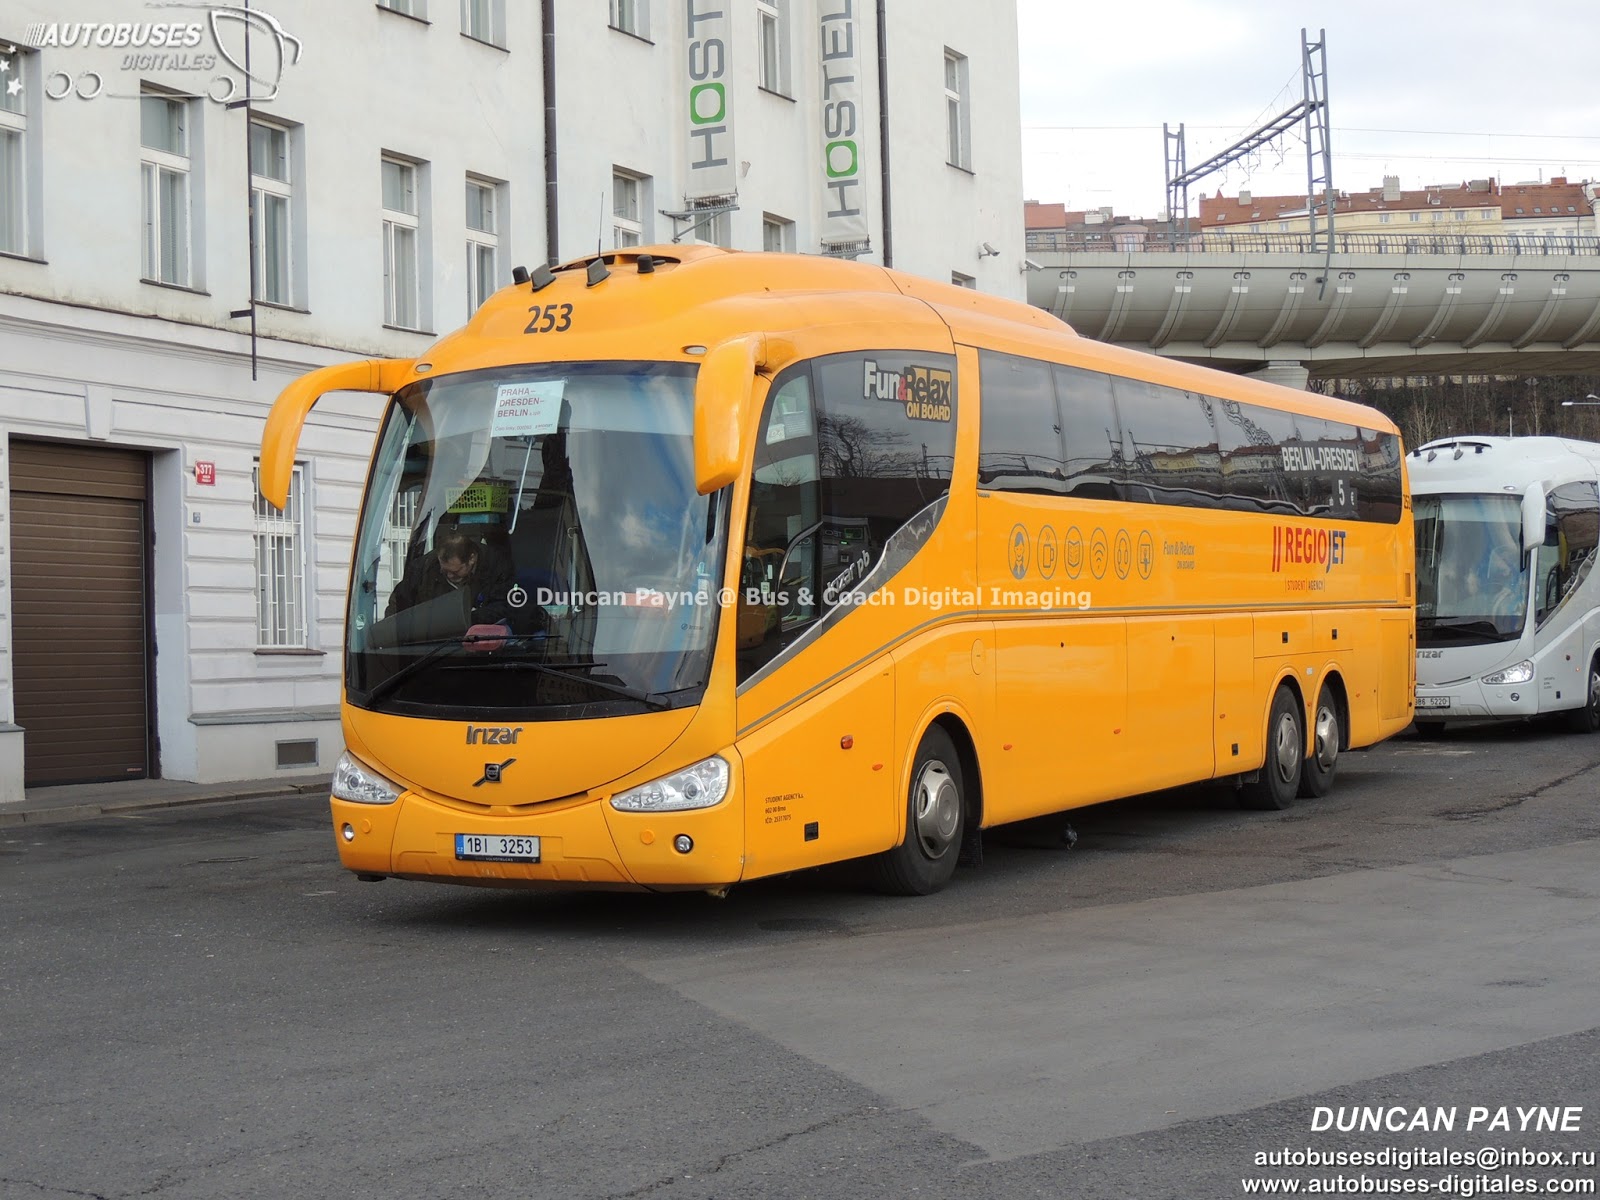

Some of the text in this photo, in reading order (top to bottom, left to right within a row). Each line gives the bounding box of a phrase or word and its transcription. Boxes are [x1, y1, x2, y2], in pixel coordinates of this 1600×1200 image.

[821, 0, 860, 218] HOSTEL
[523, 303, 573, 334] 253
[497, 409, 528, 417] BERLIN
[907, 402, 951, 421] ON BOARD
[200, 464, 212, 475] 377
[1338, 479, 1345, 506] 5
[1285, 526, 1346, 573] REGIOJET
[856, 549, 870, 579] pb
[1287, 579, 1324, 591] STUDENT AGENCY
[1416, 650, 1443, 659] rizar
[1430, 698, 1447, 706] 5220
[765, 795, 783, 803] STUDENT
[500, 838, 533, 855] 3253
